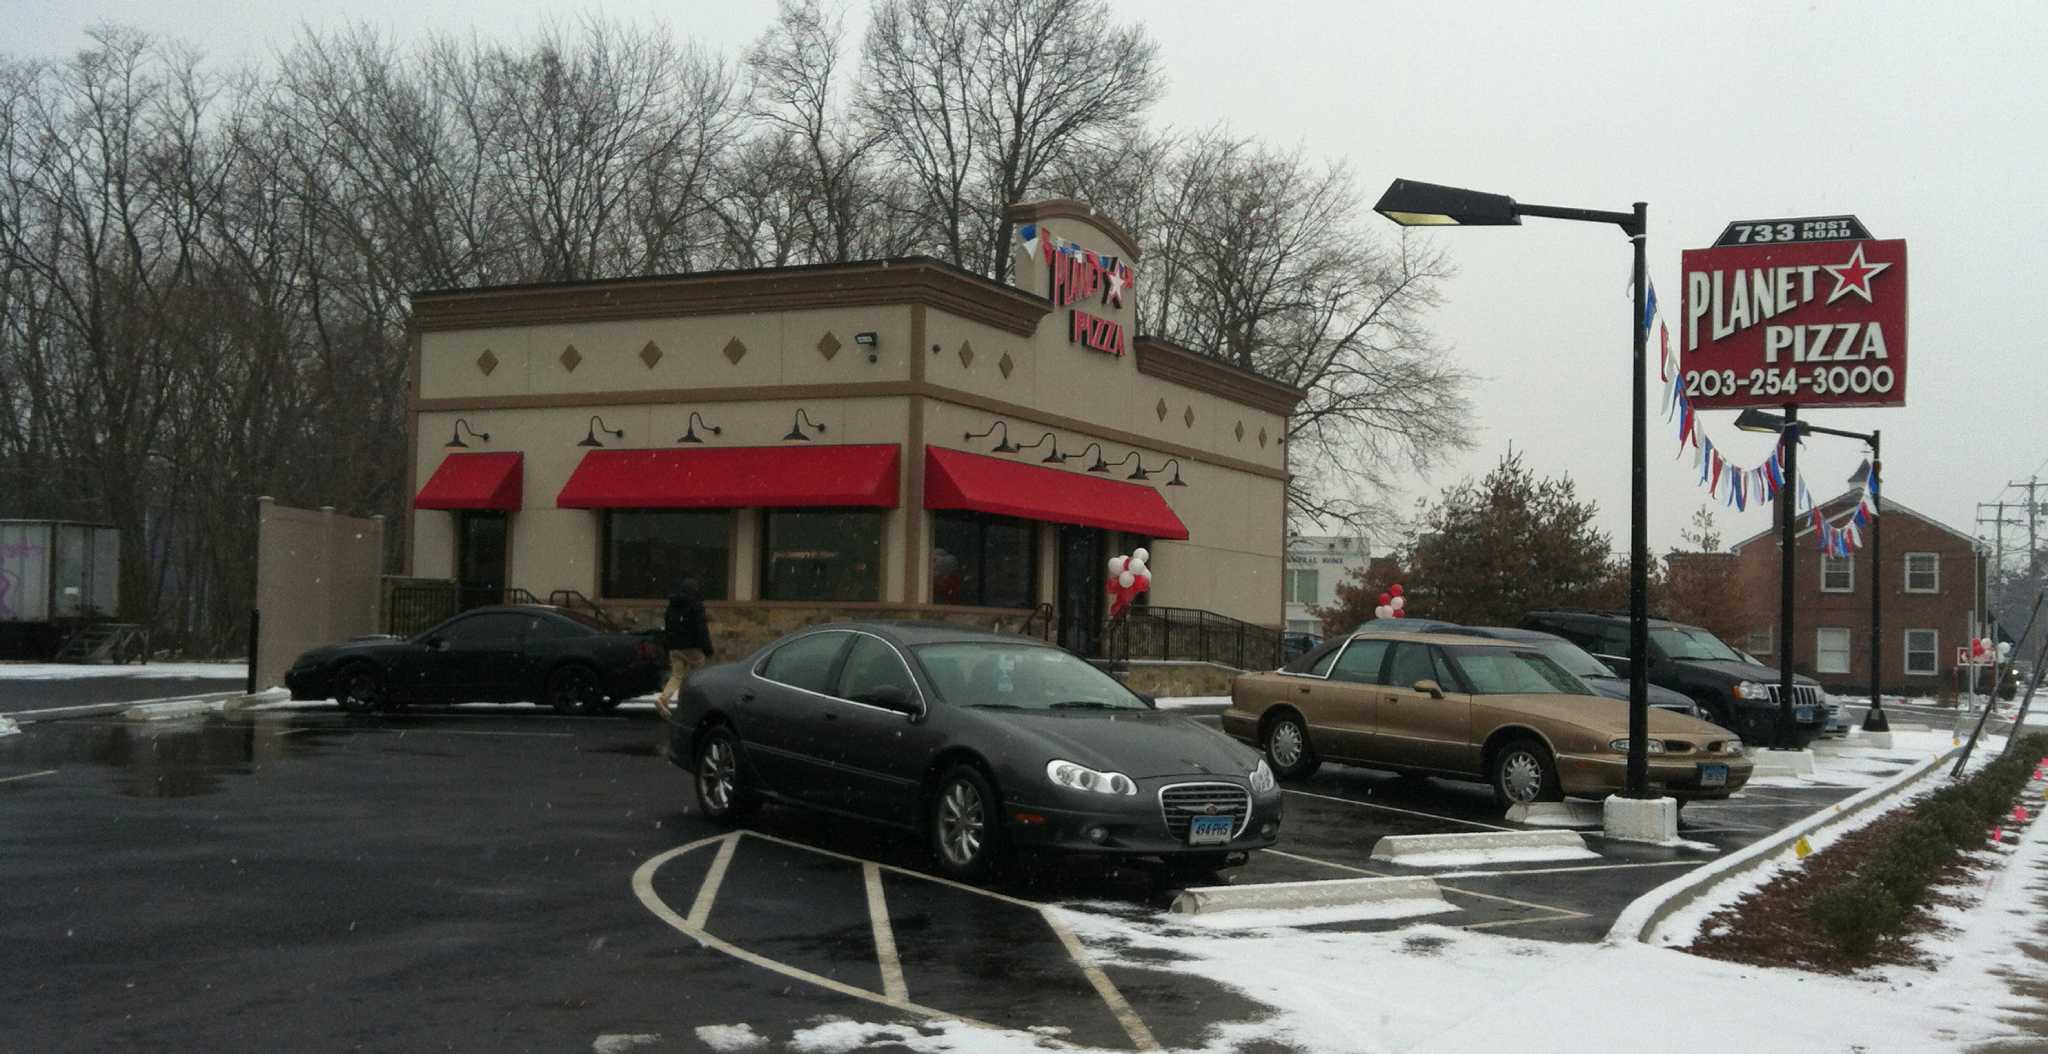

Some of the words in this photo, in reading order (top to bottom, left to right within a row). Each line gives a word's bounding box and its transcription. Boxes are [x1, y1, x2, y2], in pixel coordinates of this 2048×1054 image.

[1735, 224, 1796, 243] 733
[1803, 220, 1849, 230] POST
[1802, 229, 1851, 239] ROAD
[1688, 265, 1820, 351] PLANET
[1070, 309, 1125, 357] PIZZA
[1765, 321, 1889, 363] PIZZA
[1685, 365, 1895, 397] 203-254-3000
